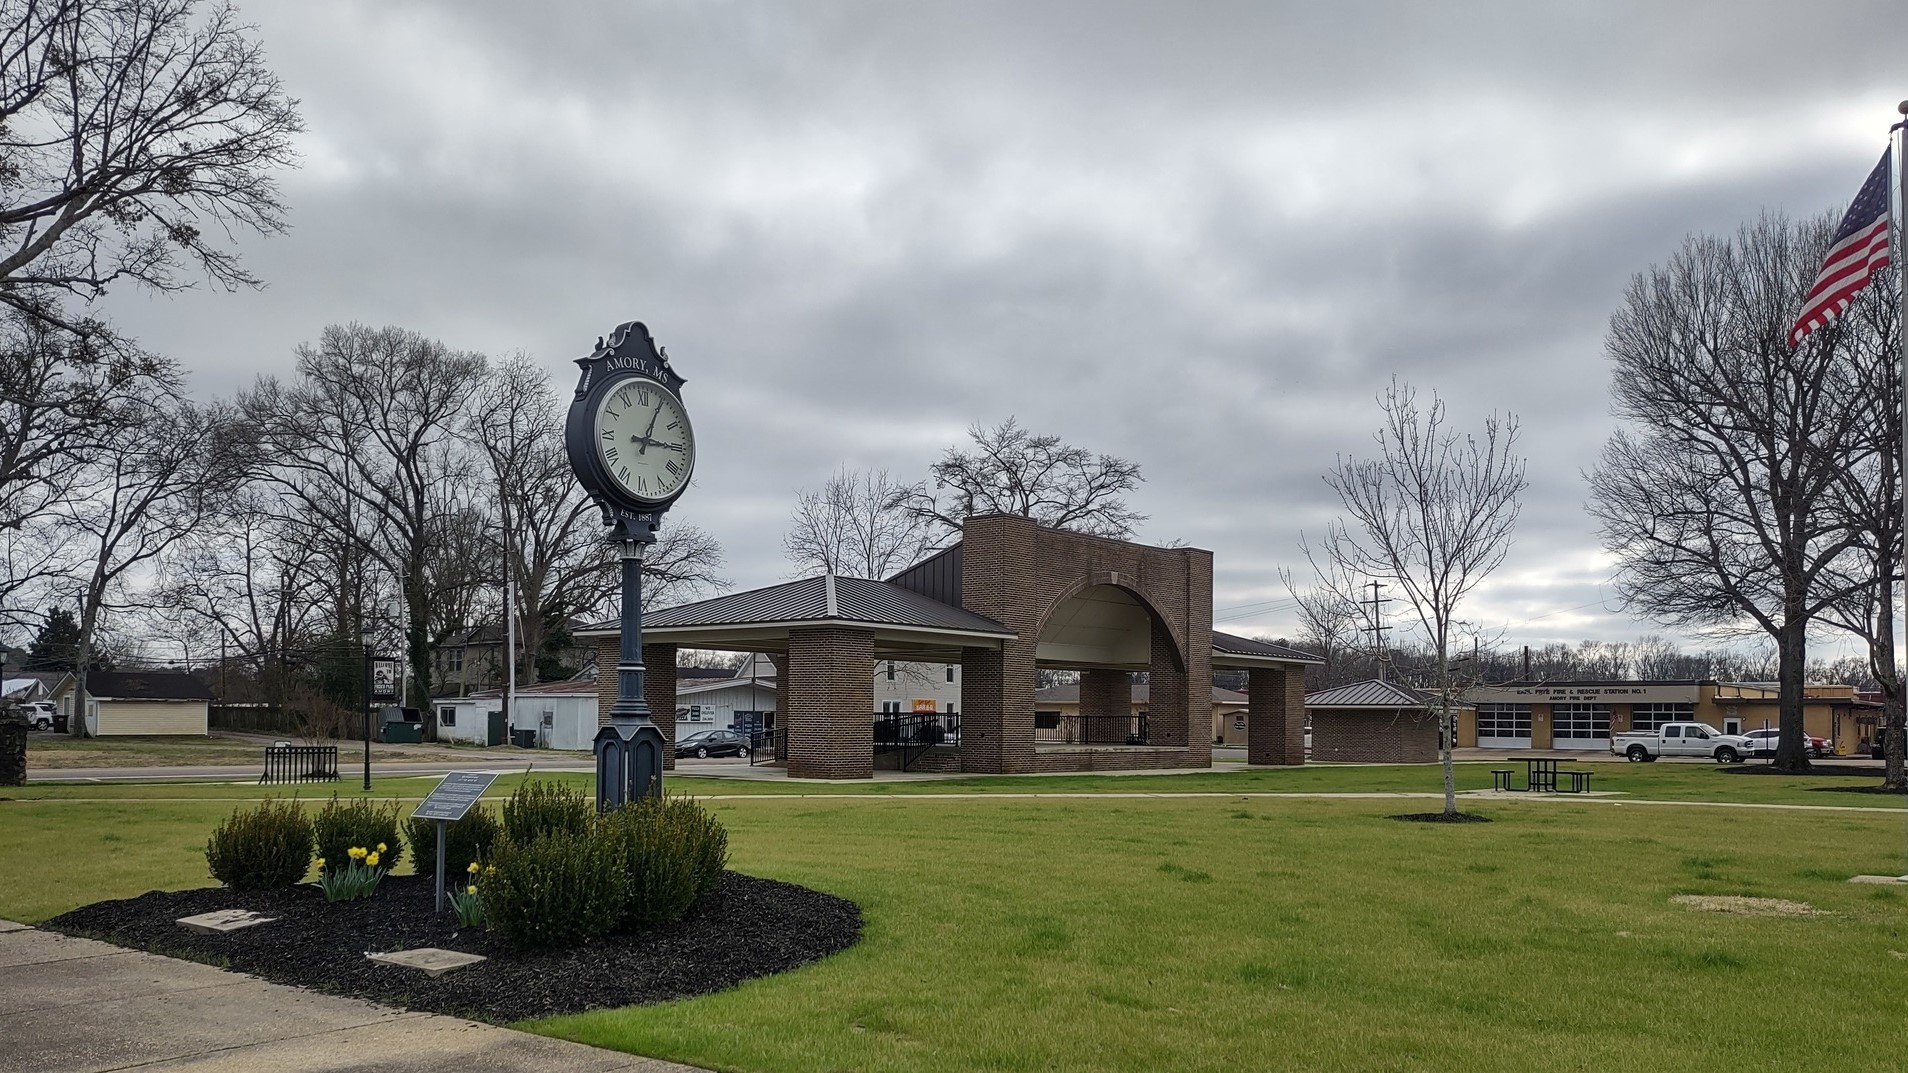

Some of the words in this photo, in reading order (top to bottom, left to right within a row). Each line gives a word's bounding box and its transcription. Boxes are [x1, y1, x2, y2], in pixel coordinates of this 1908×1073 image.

[606, 357, 649, 374] AMORY,
[653, 366, 669, 383] MS
[619, 391, 632, 409] XI
[637, 389, 650, 407] XII
[606, 405, 620, 421] X
[602, 428, 615, 441] IX
[666, 421, 678, 431] II
[604, 447, 618, 467] VIII
[618, 467, 631, 485] VII
[638, 475, 648, 492] VI
[656, 474, 666, 490] V
[620, 509, 636, 520] EST.
[638, 513, 652, 522] 1887
